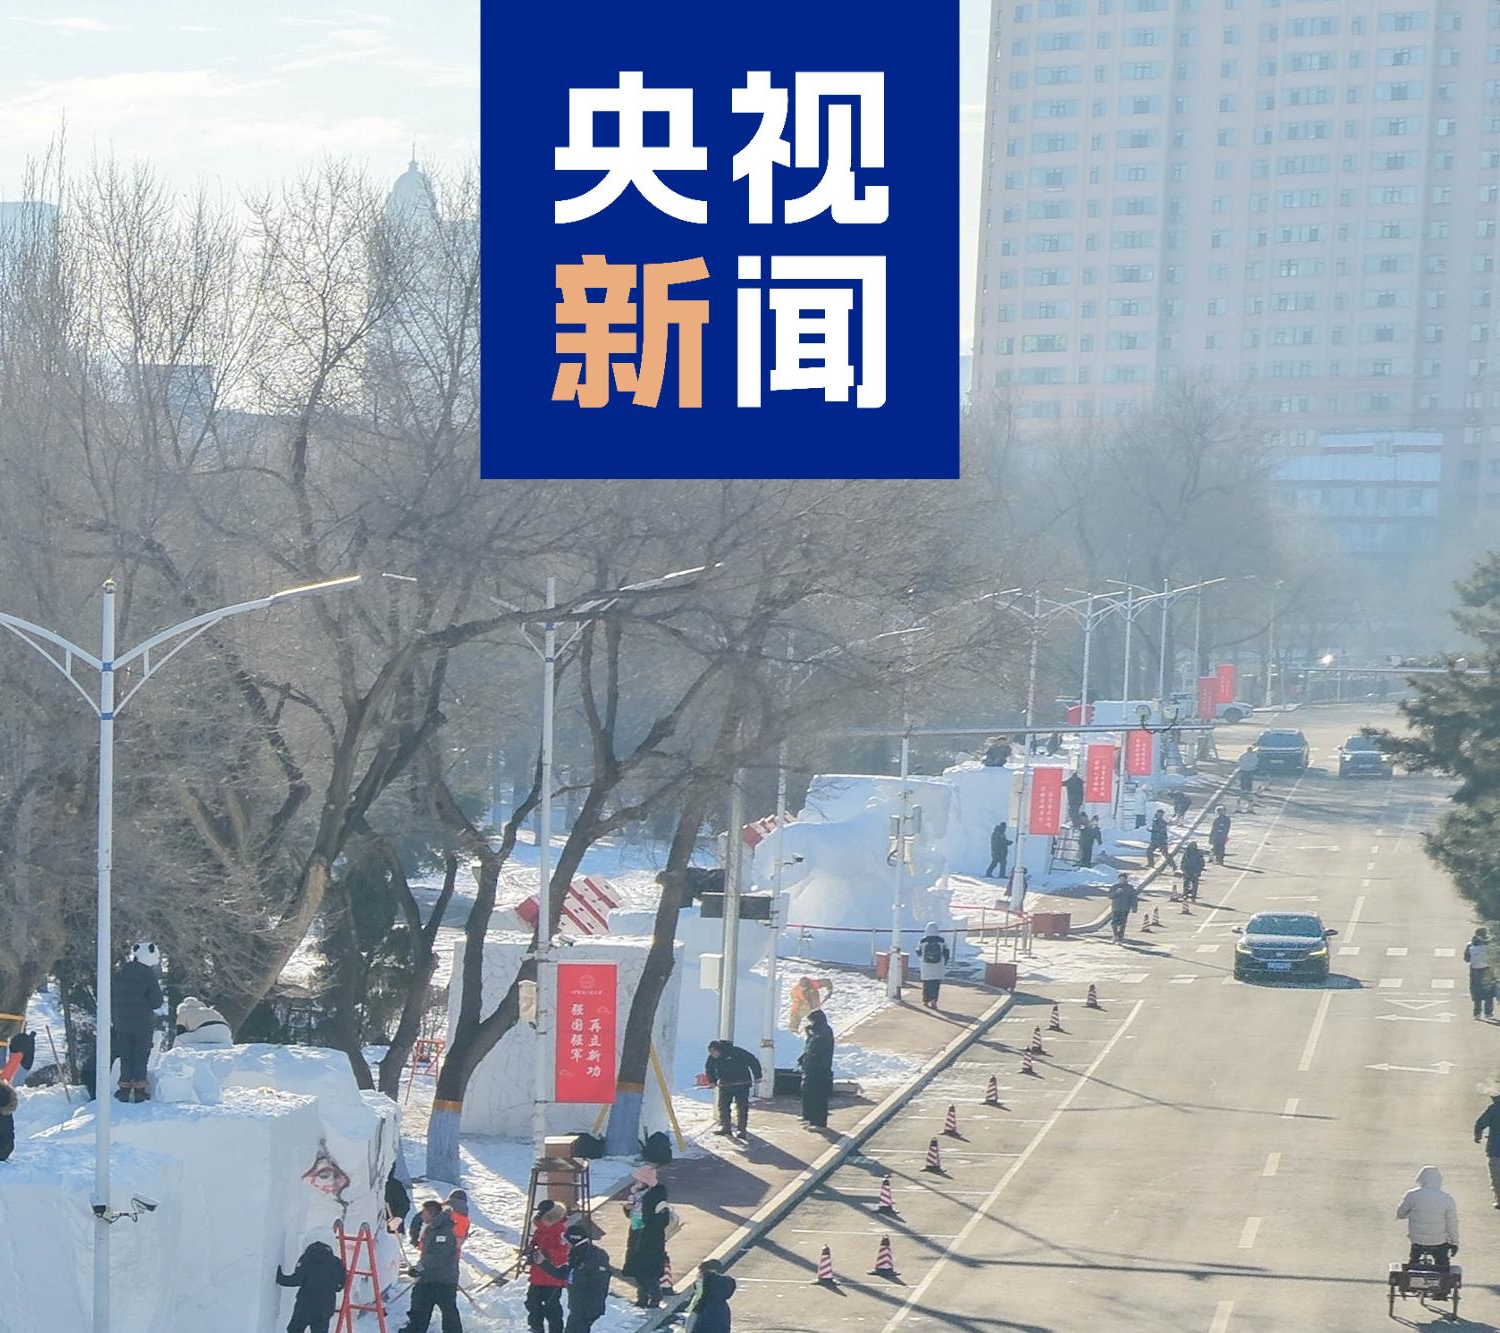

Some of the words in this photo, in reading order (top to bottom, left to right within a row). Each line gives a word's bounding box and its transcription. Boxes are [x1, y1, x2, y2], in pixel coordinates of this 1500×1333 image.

[570, 1003, 584, 1063] 强国强军
[586, 1018, 602, 1078] 再立新功
